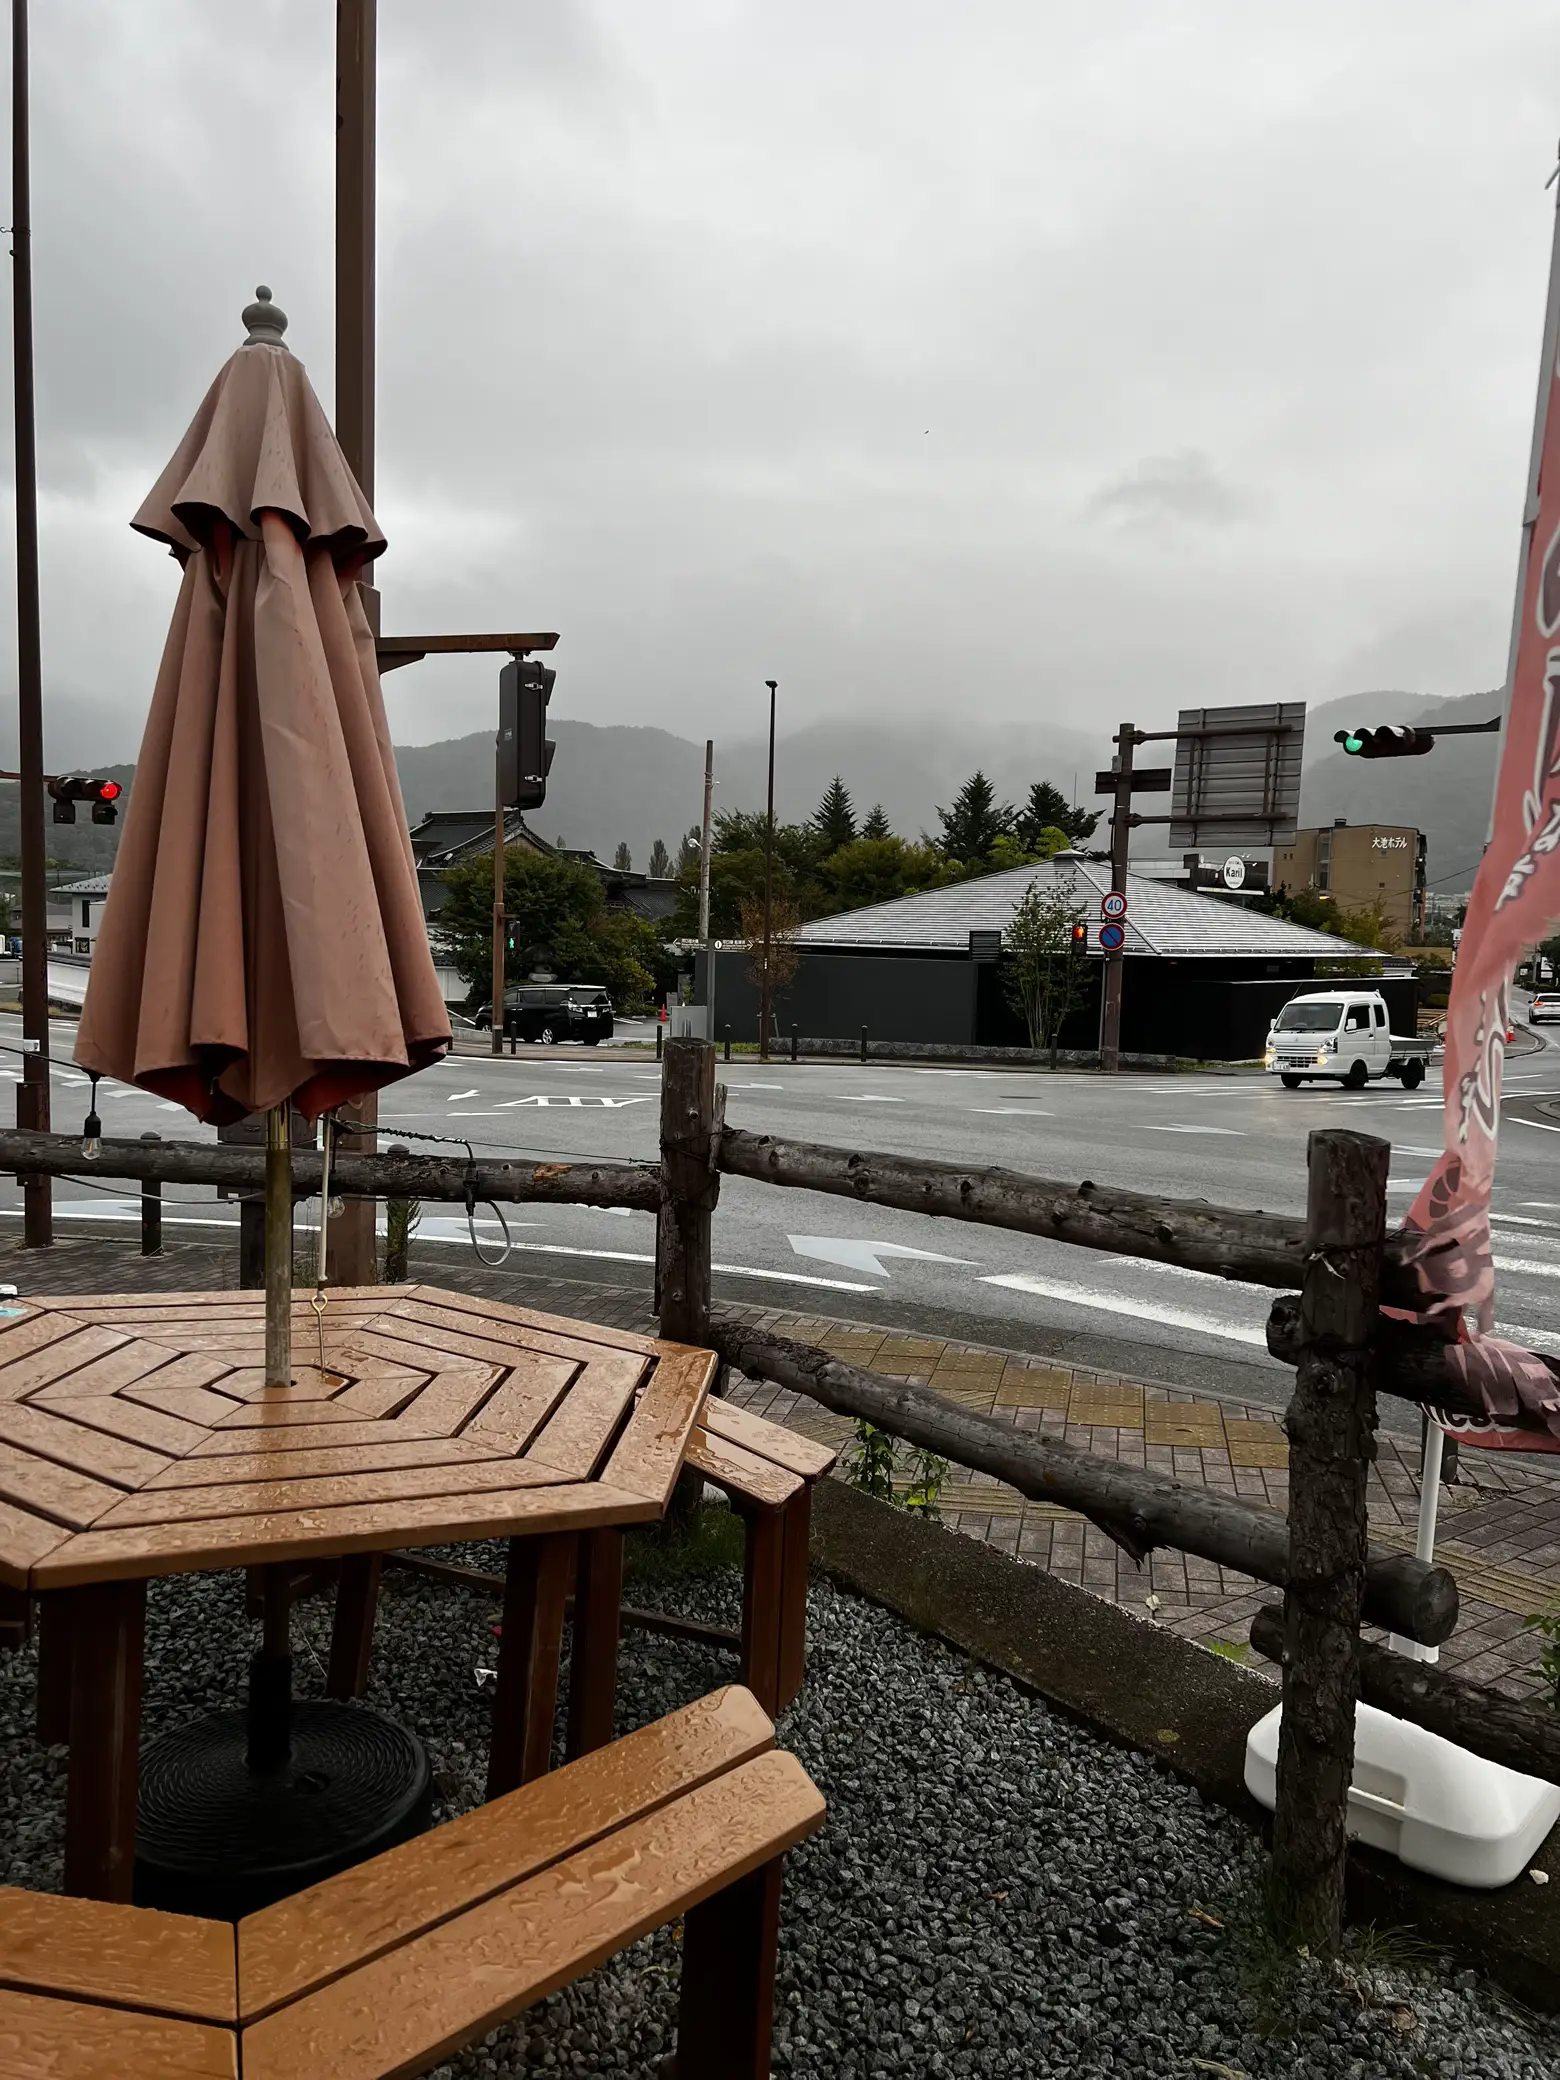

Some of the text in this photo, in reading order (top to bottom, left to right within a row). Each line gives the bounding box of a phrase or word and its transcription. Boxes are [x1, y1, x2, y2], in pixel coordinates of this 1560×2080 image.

[1371, 837, 1408, 849] 大池ホテル
[1107, 899, 1122, 911] 40
